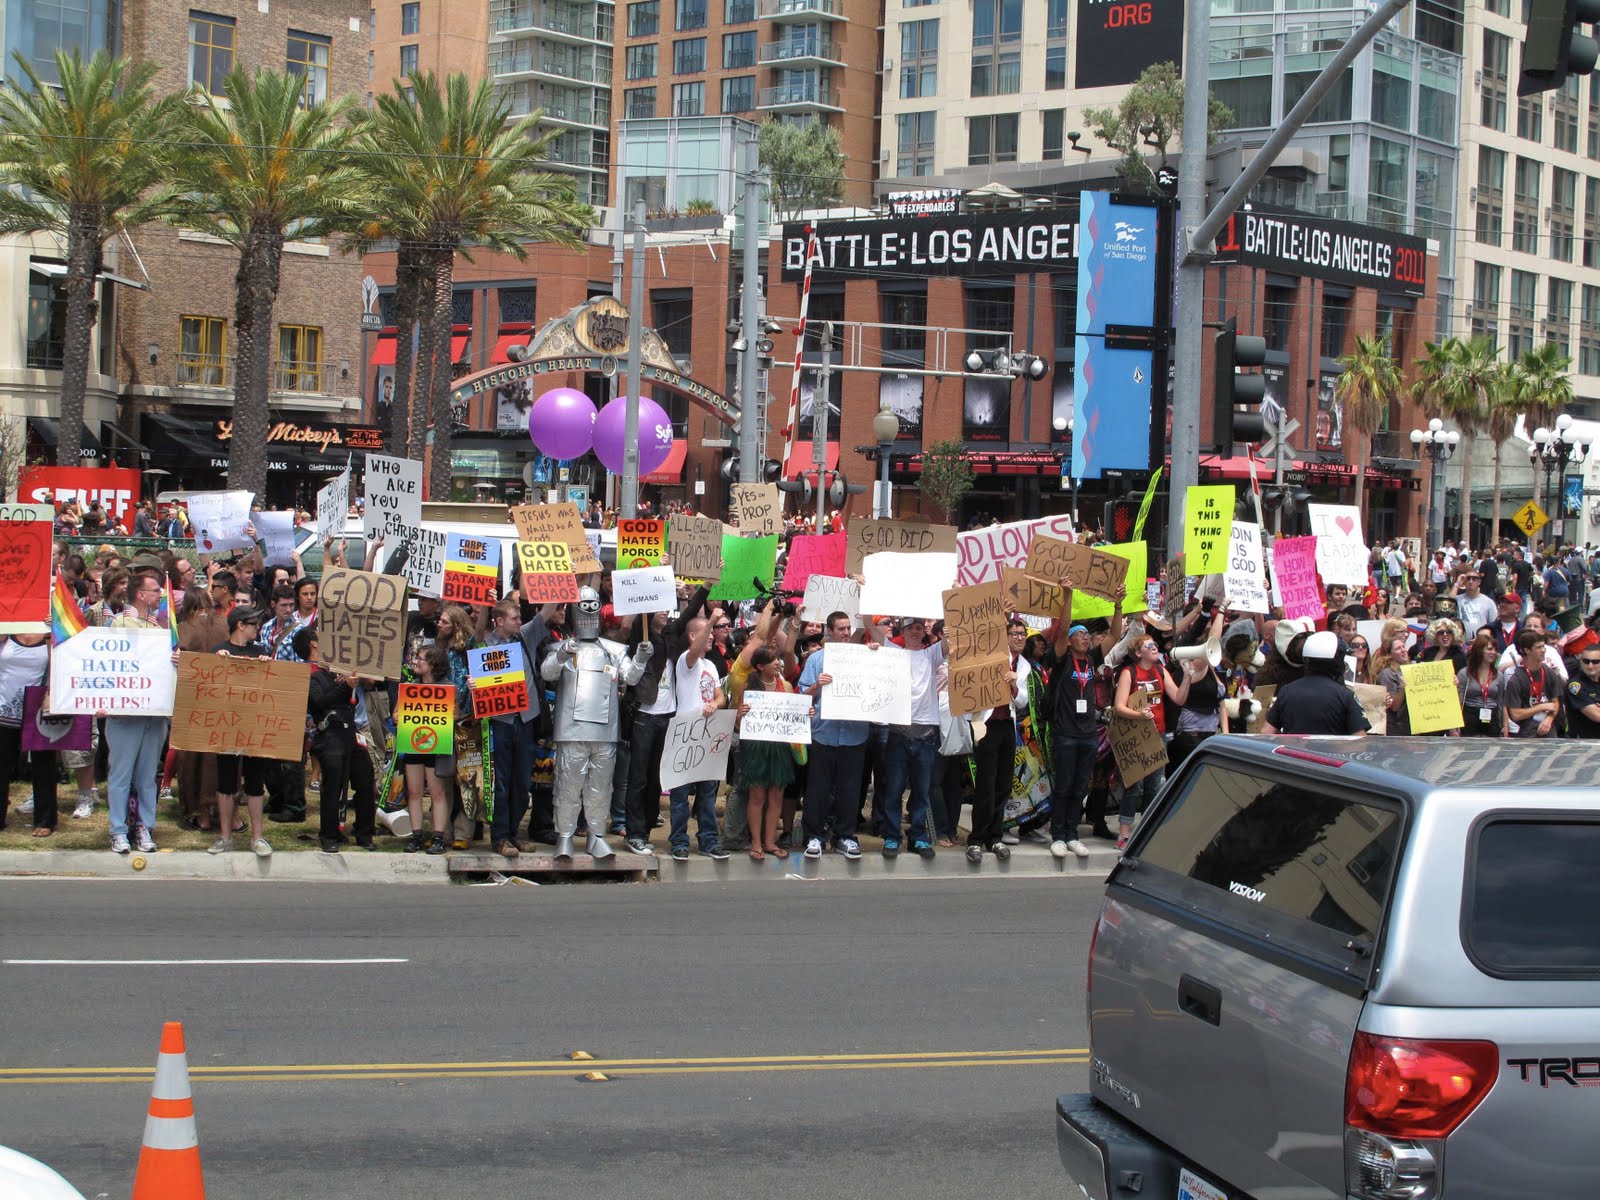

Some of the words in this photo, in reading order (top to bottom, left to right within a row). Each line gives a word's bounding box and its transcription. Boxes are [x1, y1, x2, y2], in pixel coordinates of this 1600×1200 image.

[1103, 3, 1153, 29] .ORG
[894, 203, 908, 215] THE
[907, 201, 956, 213] EXPENDABLES
[977, 223, 1079, 263] ANGE
[1104, 242, 1130, 253] Unified
[1131, 243, 1147, 254] Port
[1112, 251, 1124, 261] San
[1125, 252, 1148, 262] Diego
[1331, 234, 1392, 279] ANGELES
[1395, 247, 1425, 285] 2011
[472, 362, 543, 394] HISTORIC
[547, 357, 593, 372] HEART
[655, 368, 680, 385] SAN
[688, 381, 730, 411] DIEGO
[352, 431, 362, 439] AT
[370, 459, 401, 475] WHO
[386, 477, 416, 494] ARE
[318, 484, 348, 517] FORGIVES
[369, 493, 399, 509] YOU
[737, 491, 757, 507] YES
[1205, 498, 1214, 507] IS
[519, 508, 552, 525] JESUS
[741, 503, 772, 521] PROP
[1198, 510, 1220, 520] THIS
[567, 520, 574, 530] A
[623, 521, 658, 534] GOD
[669, 516, 692, 533] ALL
[763, 517, 774, 530] 19
[1194, 526, 1222, 537] THING
[1314, 514, 1334, 538] I
[384, 521, 448, 548] CHRISTIAN
[621, 536, 660, 546] HATES
[688, 533, 696, 541] TO
[861, 525, 895, 548] GOD
[900, 528, 934, 552] DID
[459, 538, 488, 551] CARPE
[520, 544, 565, 559] GOD
[621, 547, 659, 558] PORGS
[1034, 540, 1077, 562] GOD
[1200, 541, 1213, 550] ON
[1235, 543, 1247, 557] IS
[1320, 543, 1357, 560] LADY
[458, 548, 488, 561] CHAOS
[409, 555, 443, 575] READ
[525, 559, 569, 572] HATES
[1032, 558, 1086, 585] LOVES
[1085, 552, 1126, 591] FSM
[1232, 557, 1257, 574] GOD
[1283, 556, 1306, 573] HOW
[445, 573, 496, 589] SATAN'S
[526, 575, 574, 588] CARPE
[1228, 576, 1244, 587] READ
[1245, 579, 1257, 588] THE
[320, 573, 397, 615] GOD
[443, 584, 496, 602] BIBLE
[529, 587, 577, 601] CHAOS
[628, 593, 660, 604] HUMANS
[1281, 590, 1294, 604] DO
[1293, 585, 1318, 601] THEY
[943, 592, 1005, 629] SUPERMAN
[320, 608, 398, 641] HATES
[91, 638, 132, 652] GOD
[955, 621, 1001, 662] DIED
[322, 639, 385, 670] JEDI
[480, 649, 510, 663] CARPE
[81, 658, 141, 673] HATES
[482, 659, 511, 672] CHAOS
[953, 670, 977, 691] FOR
[980, 663, 1005, 683] OUR
[405, 685, 448, 700] GOD
[475, 684, 524, 700] SATAN'S
[961, 681, 1003, 712] SINS
[74, 696, 151, 710] PHELPS!!
[403, 701, 448, 714] HATES
[475, 693, 528, 716] BIBLE
[188, 710, 242, 729] READ
[255, 714, 293, 732] THE
[403, 714, 448, 727] PORGS
[671, 716, 717, 747] FUCK
[208, 731, 278, 749] BIBLE
[1114, 735, 1142, 758] THERE
[1140, 726, 1152, 741] IS
[672, 744, 706, 773] GOD
[1228, 880, 1266, 904] VISION
